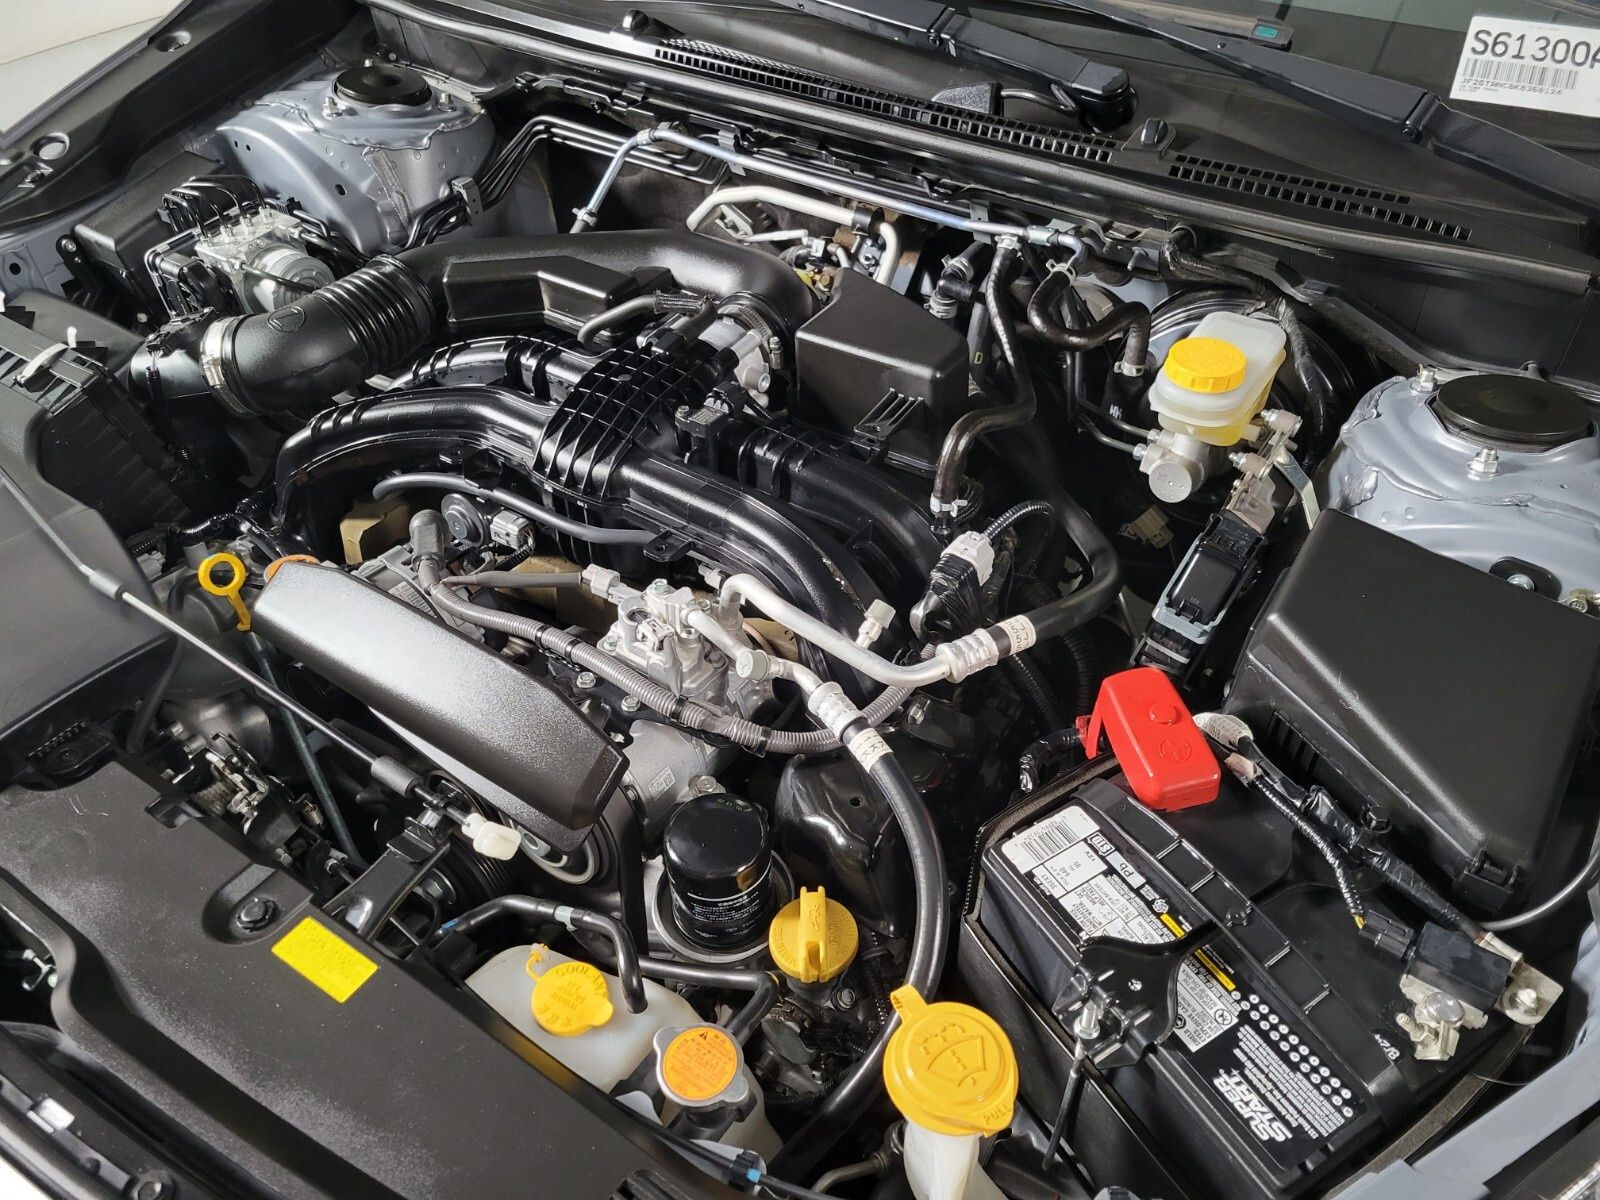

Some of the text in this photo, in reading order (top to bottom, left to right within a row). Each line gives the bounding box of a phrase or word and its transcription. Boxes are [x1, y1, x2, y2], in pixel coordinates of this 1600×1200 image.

[1117, 861, 1133, 878] Pb
[555, 964, 606, 997] COOLANT
[983, 1103, 1011, 1124] PULL
[1211, 1076, 1272, 1141] SUPER
[1221, 1073, 1289, 1140] START
